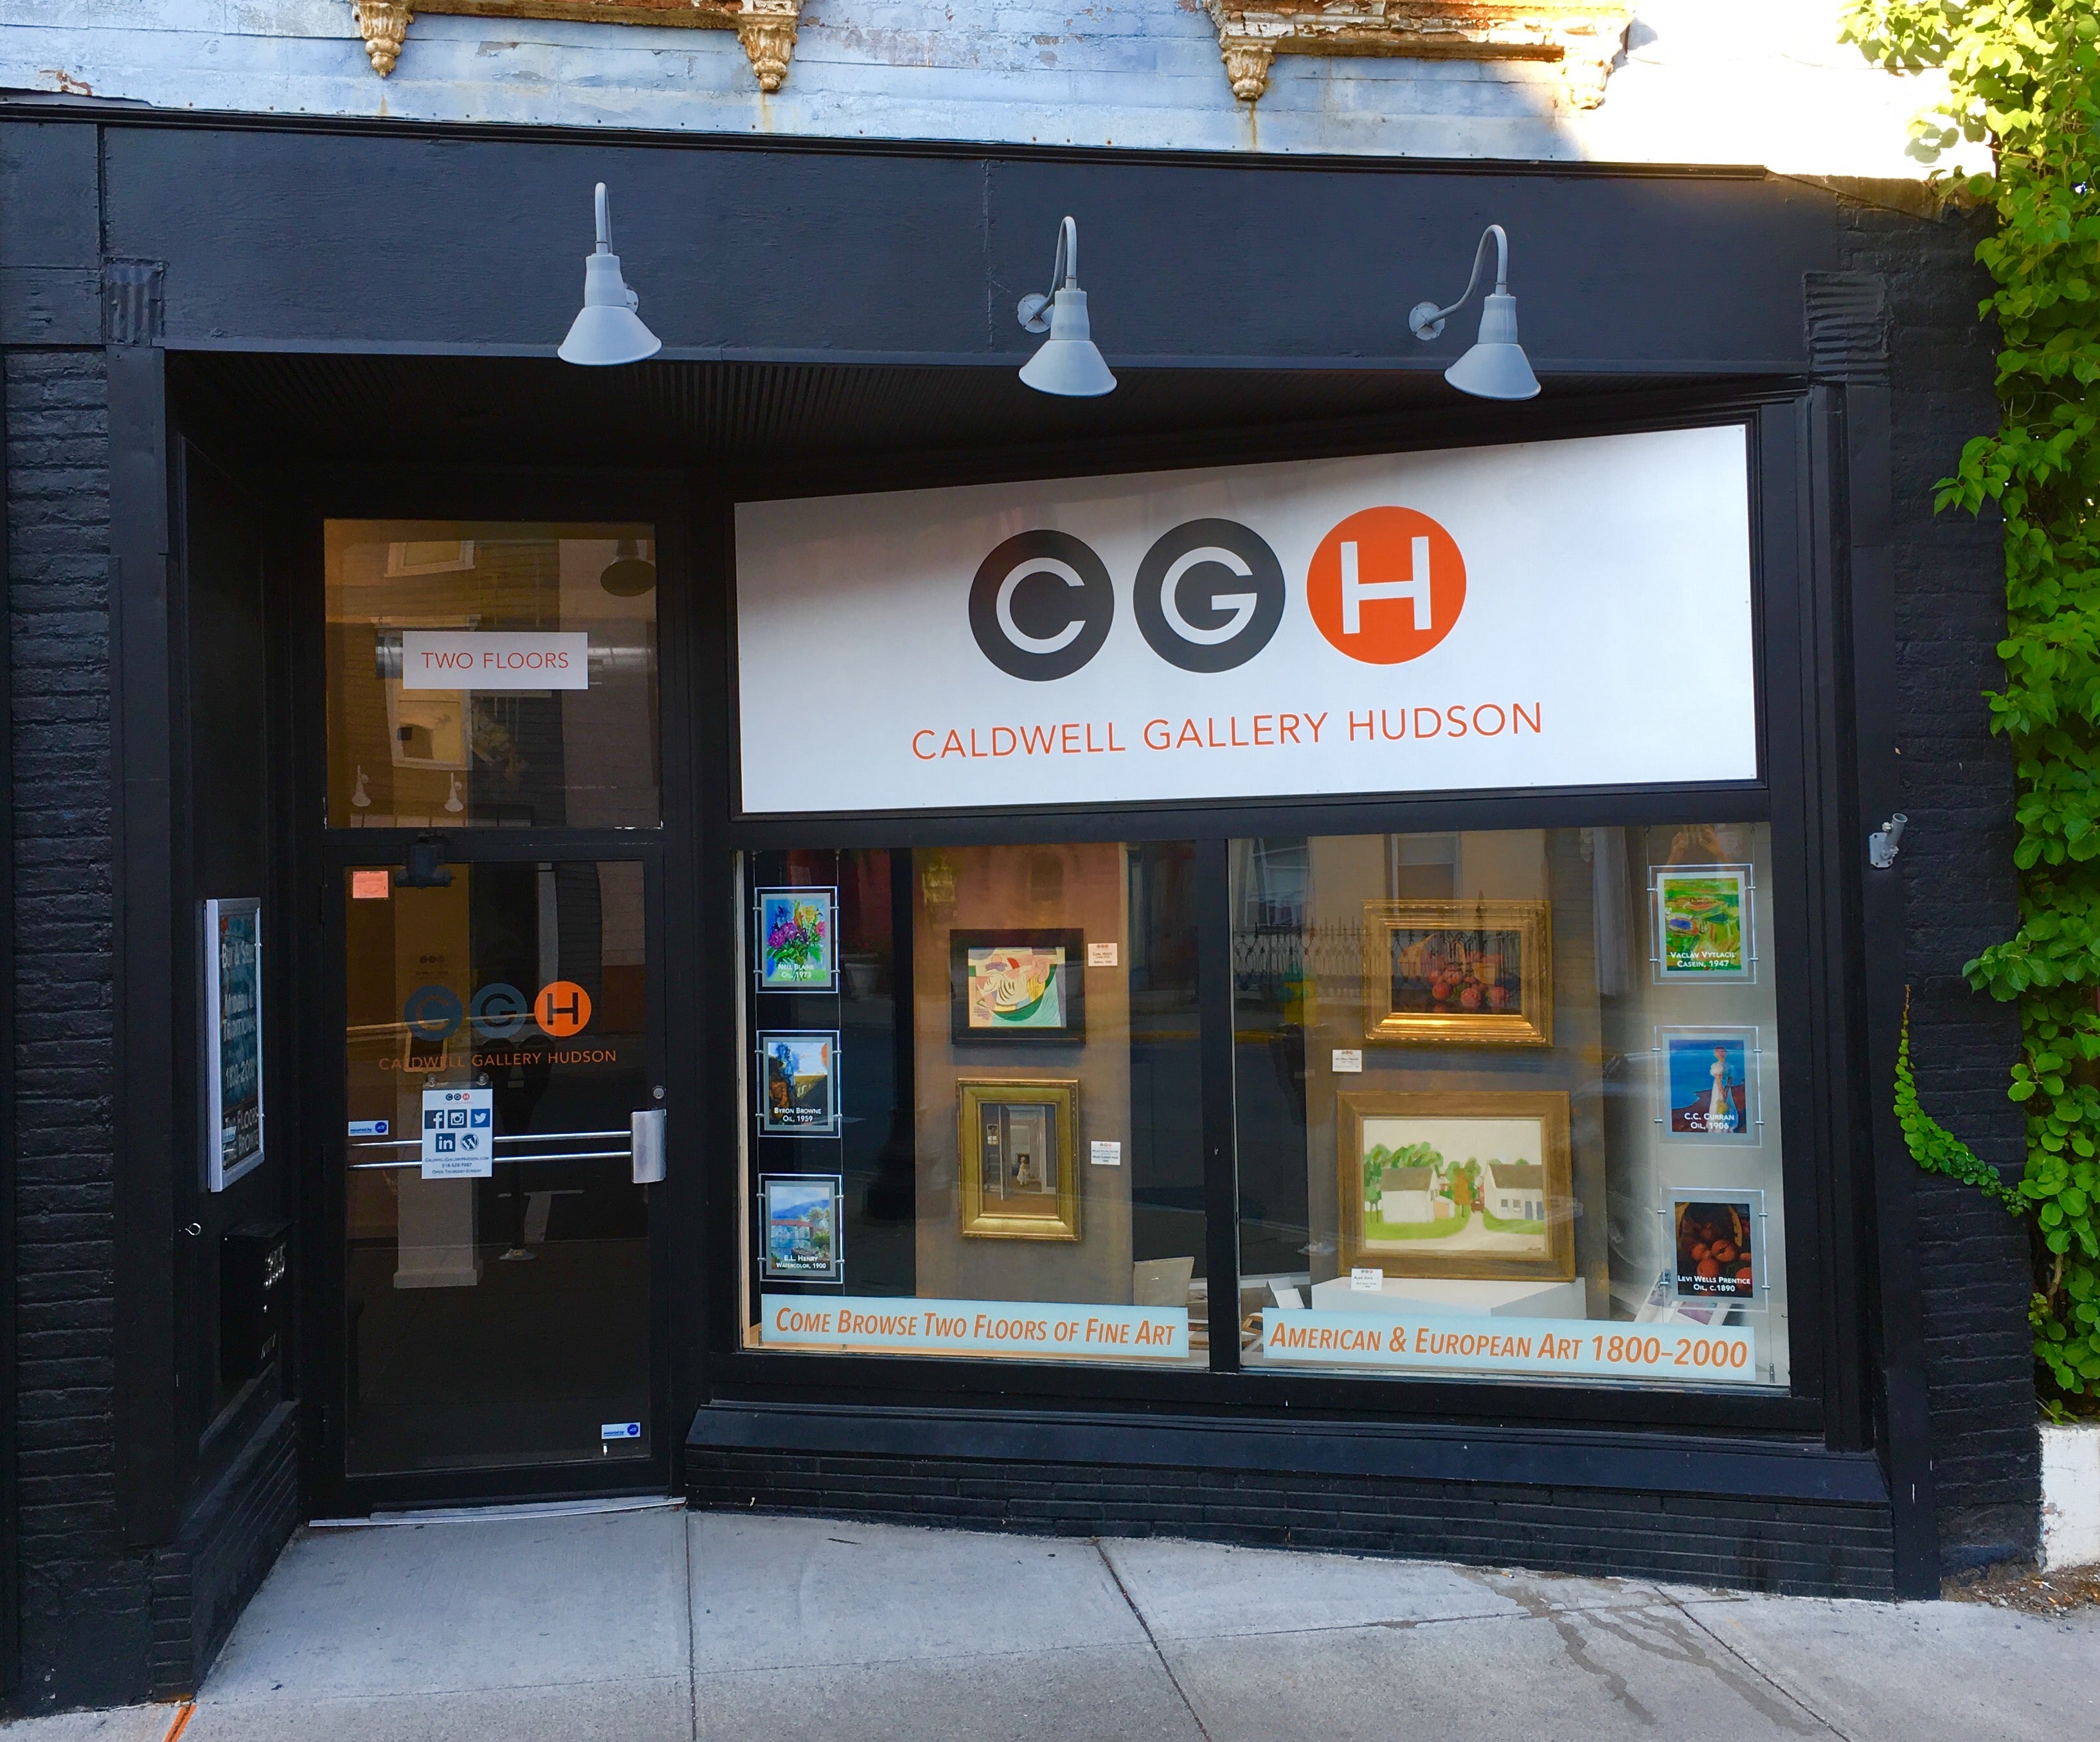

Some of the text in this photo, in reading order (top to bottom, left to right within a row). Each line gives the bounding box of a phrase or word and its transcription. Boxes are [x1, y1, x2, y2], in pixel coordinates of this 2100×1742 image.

[420, 652, 570, 669] TWO FLOORS
[911, 701, 1543, 760] CALDWELL GALLERY HUDSON
[379, 1050, 617, 1070] CALDWELL GALLERY HUDSON
[776, 1307, 1176, 1345] COME BROWSE TWO FLOORS OF FINE ART
[1269, 1322, 1748, 1368] AMERICAN & EUROPEAN ART 1800-2000
